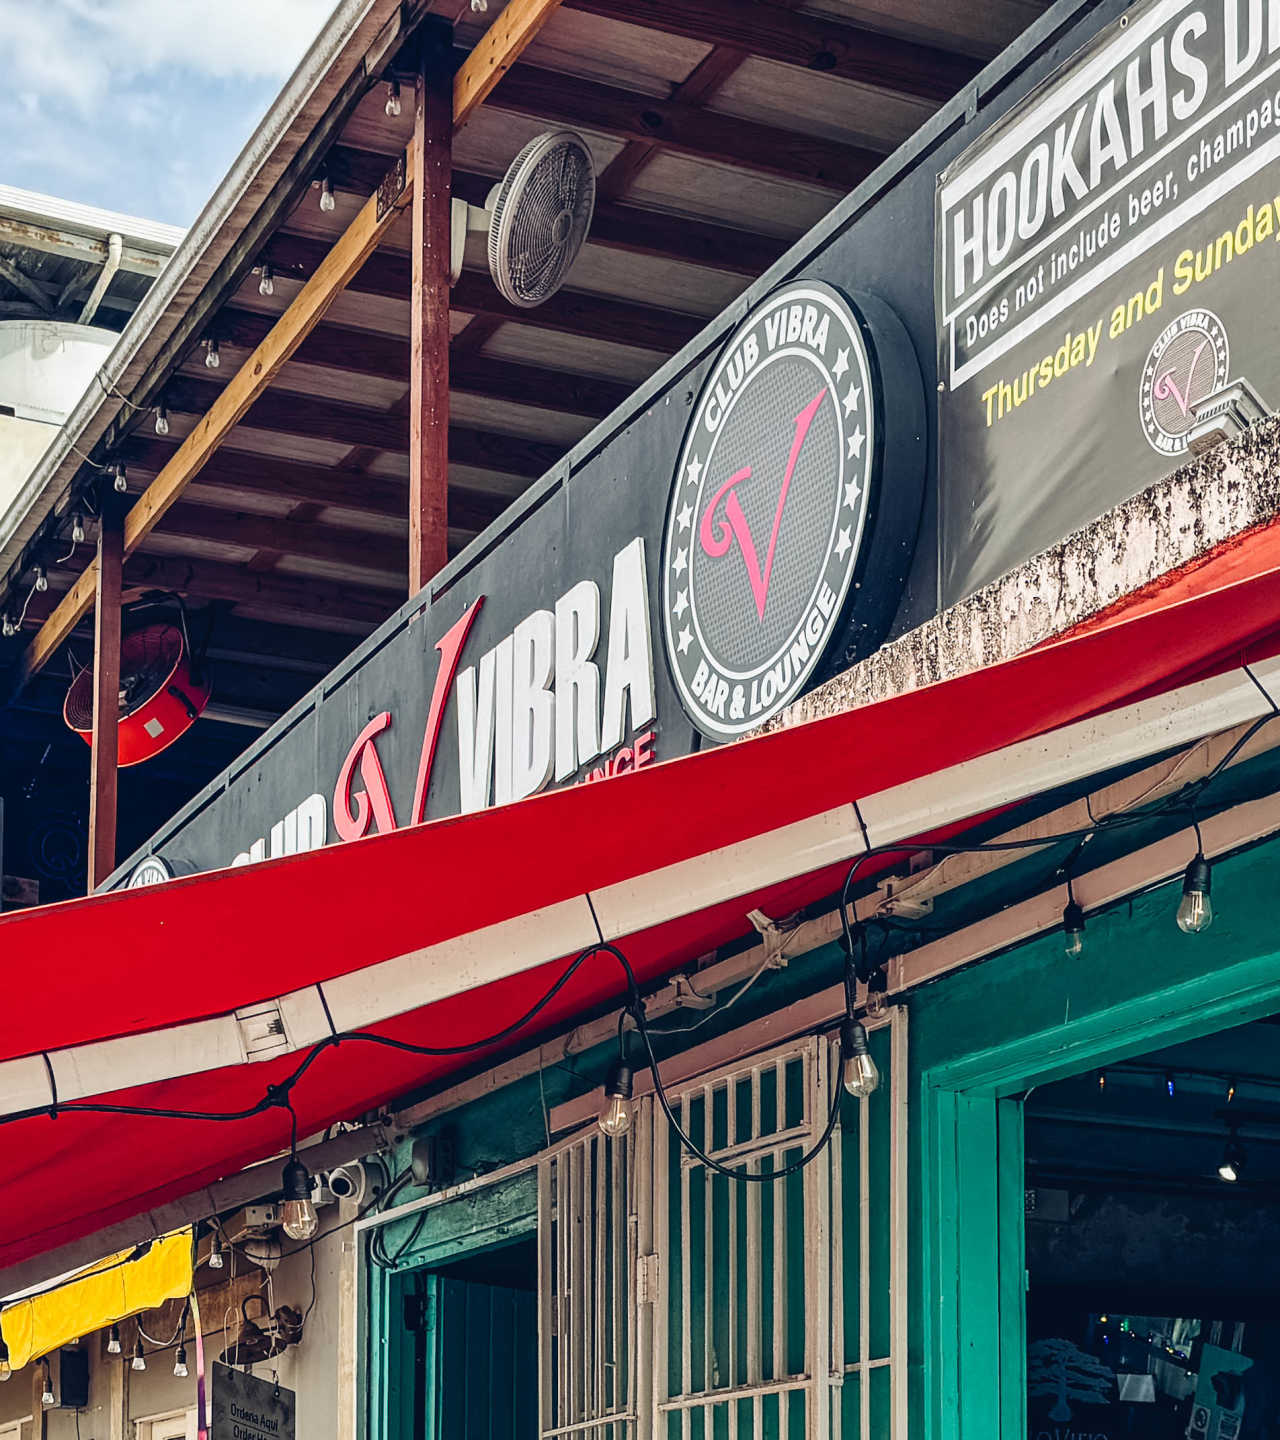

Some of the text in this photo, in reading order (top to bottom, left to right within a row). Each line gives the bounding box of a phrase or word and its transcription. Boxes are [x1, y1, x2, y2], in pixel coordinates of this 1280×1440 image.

[952, 4, 1209, 298] HOOKAHS
[966, 296, 1011, 347] Does
[1014, 273, 1046, 314] not
[1050, 213, 1120, 286] include
[1128, 175, 1179, 227] beer,
[704, 304, 831, 435] CLUB VIBRA
[981, 317, 1104, 428] Thursday
[1108, 268, 1164, 340] and
[456, 536, 657, 814] VIBRA
[691, 657, 730, 719] BAR
[750, 580, 838, 712] LOUNGE
[231, 1403, 259, 1425] Ordena
